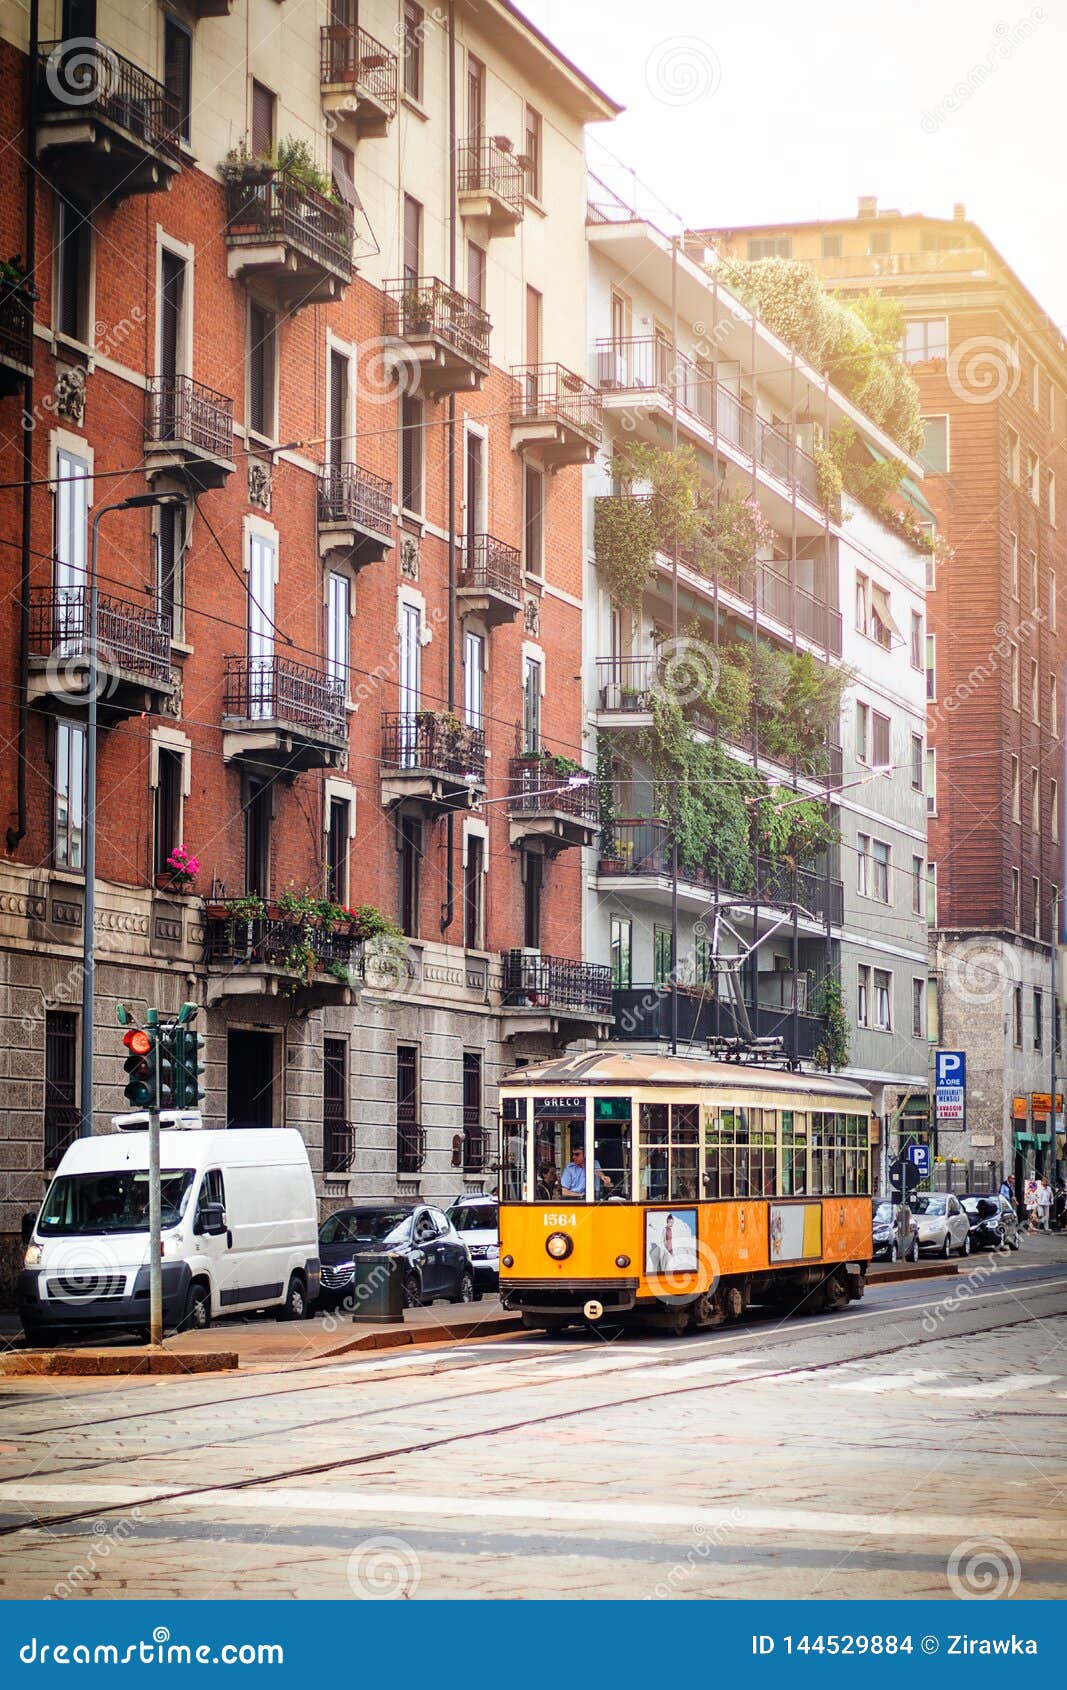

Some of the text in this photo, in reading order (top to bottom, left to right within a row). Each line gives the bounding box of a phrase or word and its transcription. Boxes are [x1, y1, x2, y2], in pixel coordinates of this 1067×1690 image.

[940, 1055, 960, 1078] P
[544, 1098, 580, 1107] GRECO
[543, 1213, 577, 1226] 1564
